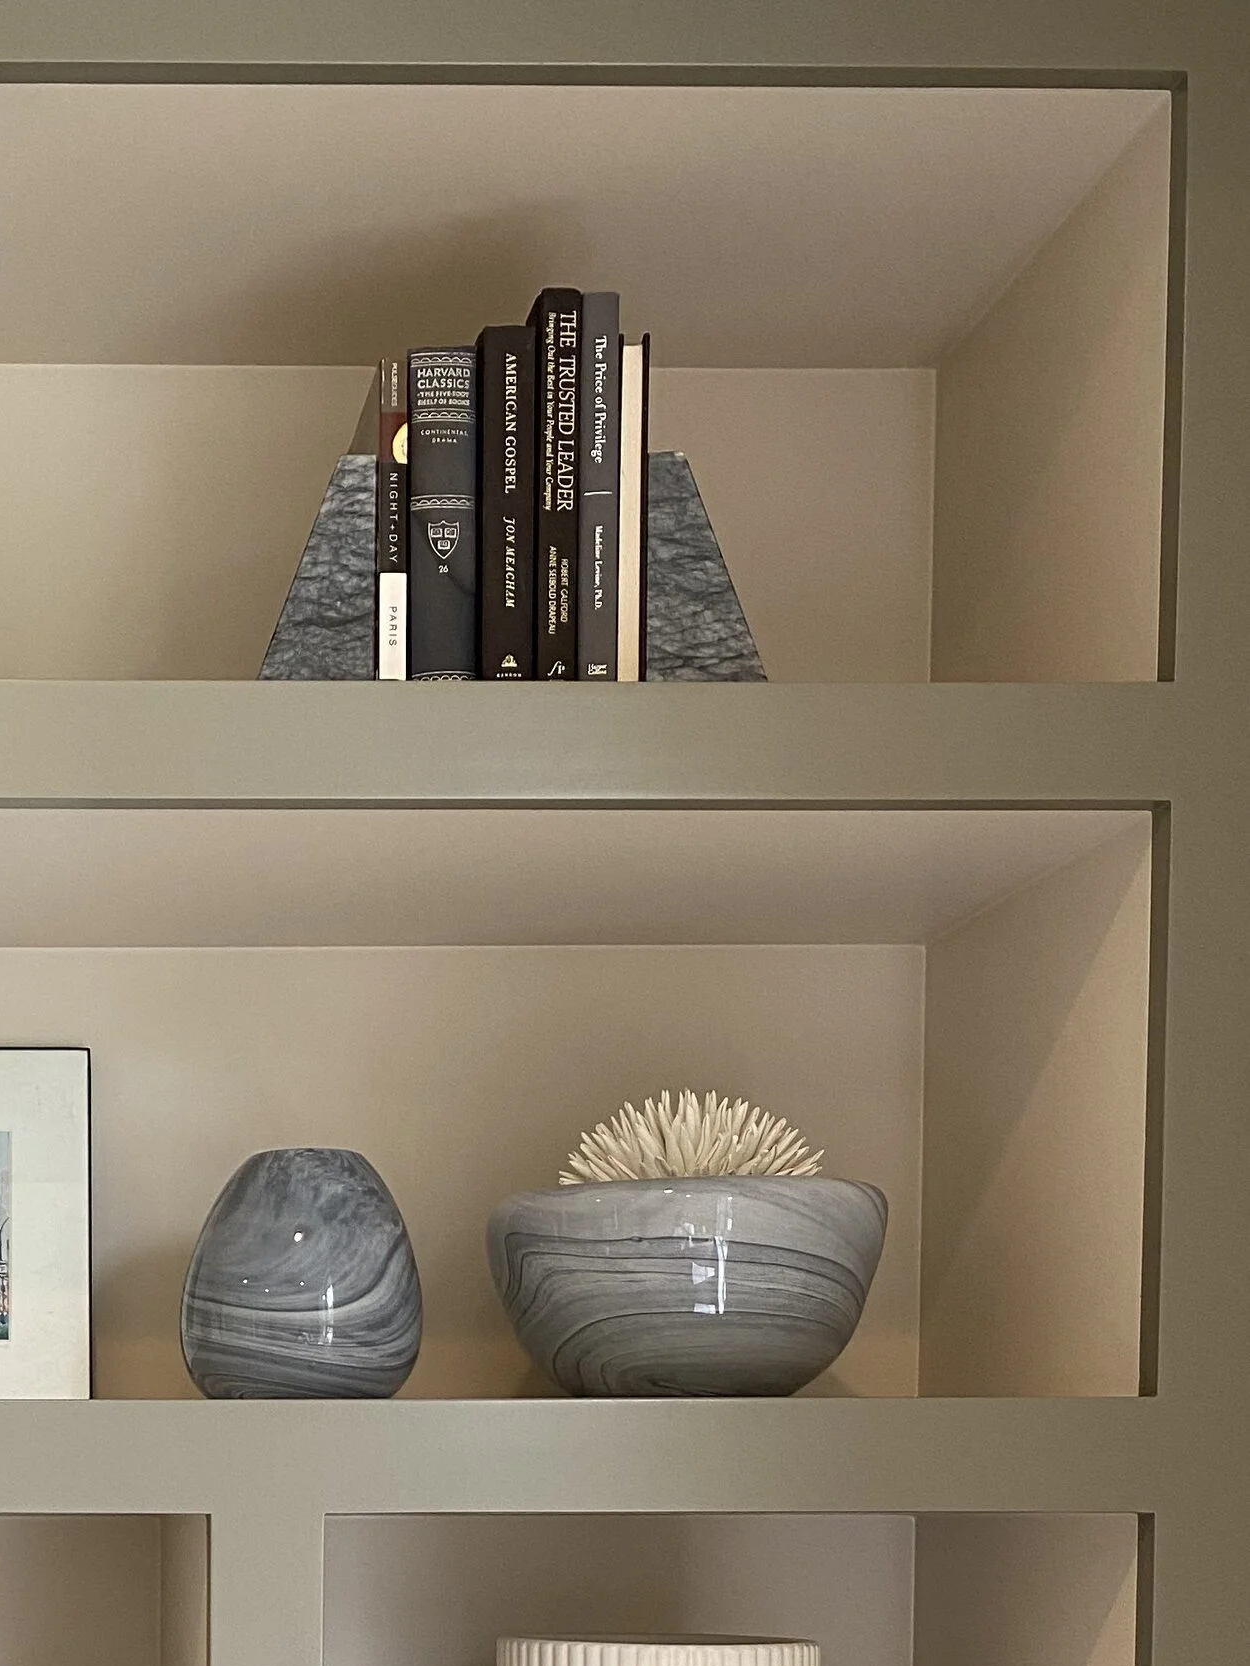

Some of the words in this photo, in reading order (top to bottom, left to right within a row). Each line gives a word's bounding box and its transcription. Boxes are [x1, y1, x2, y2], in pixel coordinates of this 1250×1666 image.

[546, 312, 556, 344] Bringing
[560, 310, 577, 348] THE
[547, 345, 556, 360] Out
[595, 335, 607, 359] The
[417, 367, 470, 379] HARVARD
[547, 362, 556, 373] the
[594, 363, 607, 394] Price
[417, 378, 470, 389] CLASSICS
[505, 353, 517, 432] AMERICAN
[547, 375, 555, 390] Best
[547, 391, 555, 399] in
[558, 355, 576, 435] TRUSTED
[546, 401, 555, 418] Your
[594, 396, 607, 409] of
[420, 429, 468, 437] CONTINENTAL
[544, 420, 555, 442] People
[590, 412, 607, 464] Privilege
[546, 443, 554, 457] and
[505, 436, 517, 494] GOSPEL
[546, 459, 554, 475] Your
[557, 440, 574, 511] LEADER
[543, 476, 554, 511] Company
[503, 516, 516, 543] JON
[595, 525, 603, 560] Madeline
[438, 565, 449, 574] 26
[549, 545, 557, 569] ANNE
[505, 546, 516, 608] MEACHAM
[560, 558, 569, 586] ROBERT
[388, 606, 398, 647] PARIS
[548, 601, 557, 634] DRAPEAU
